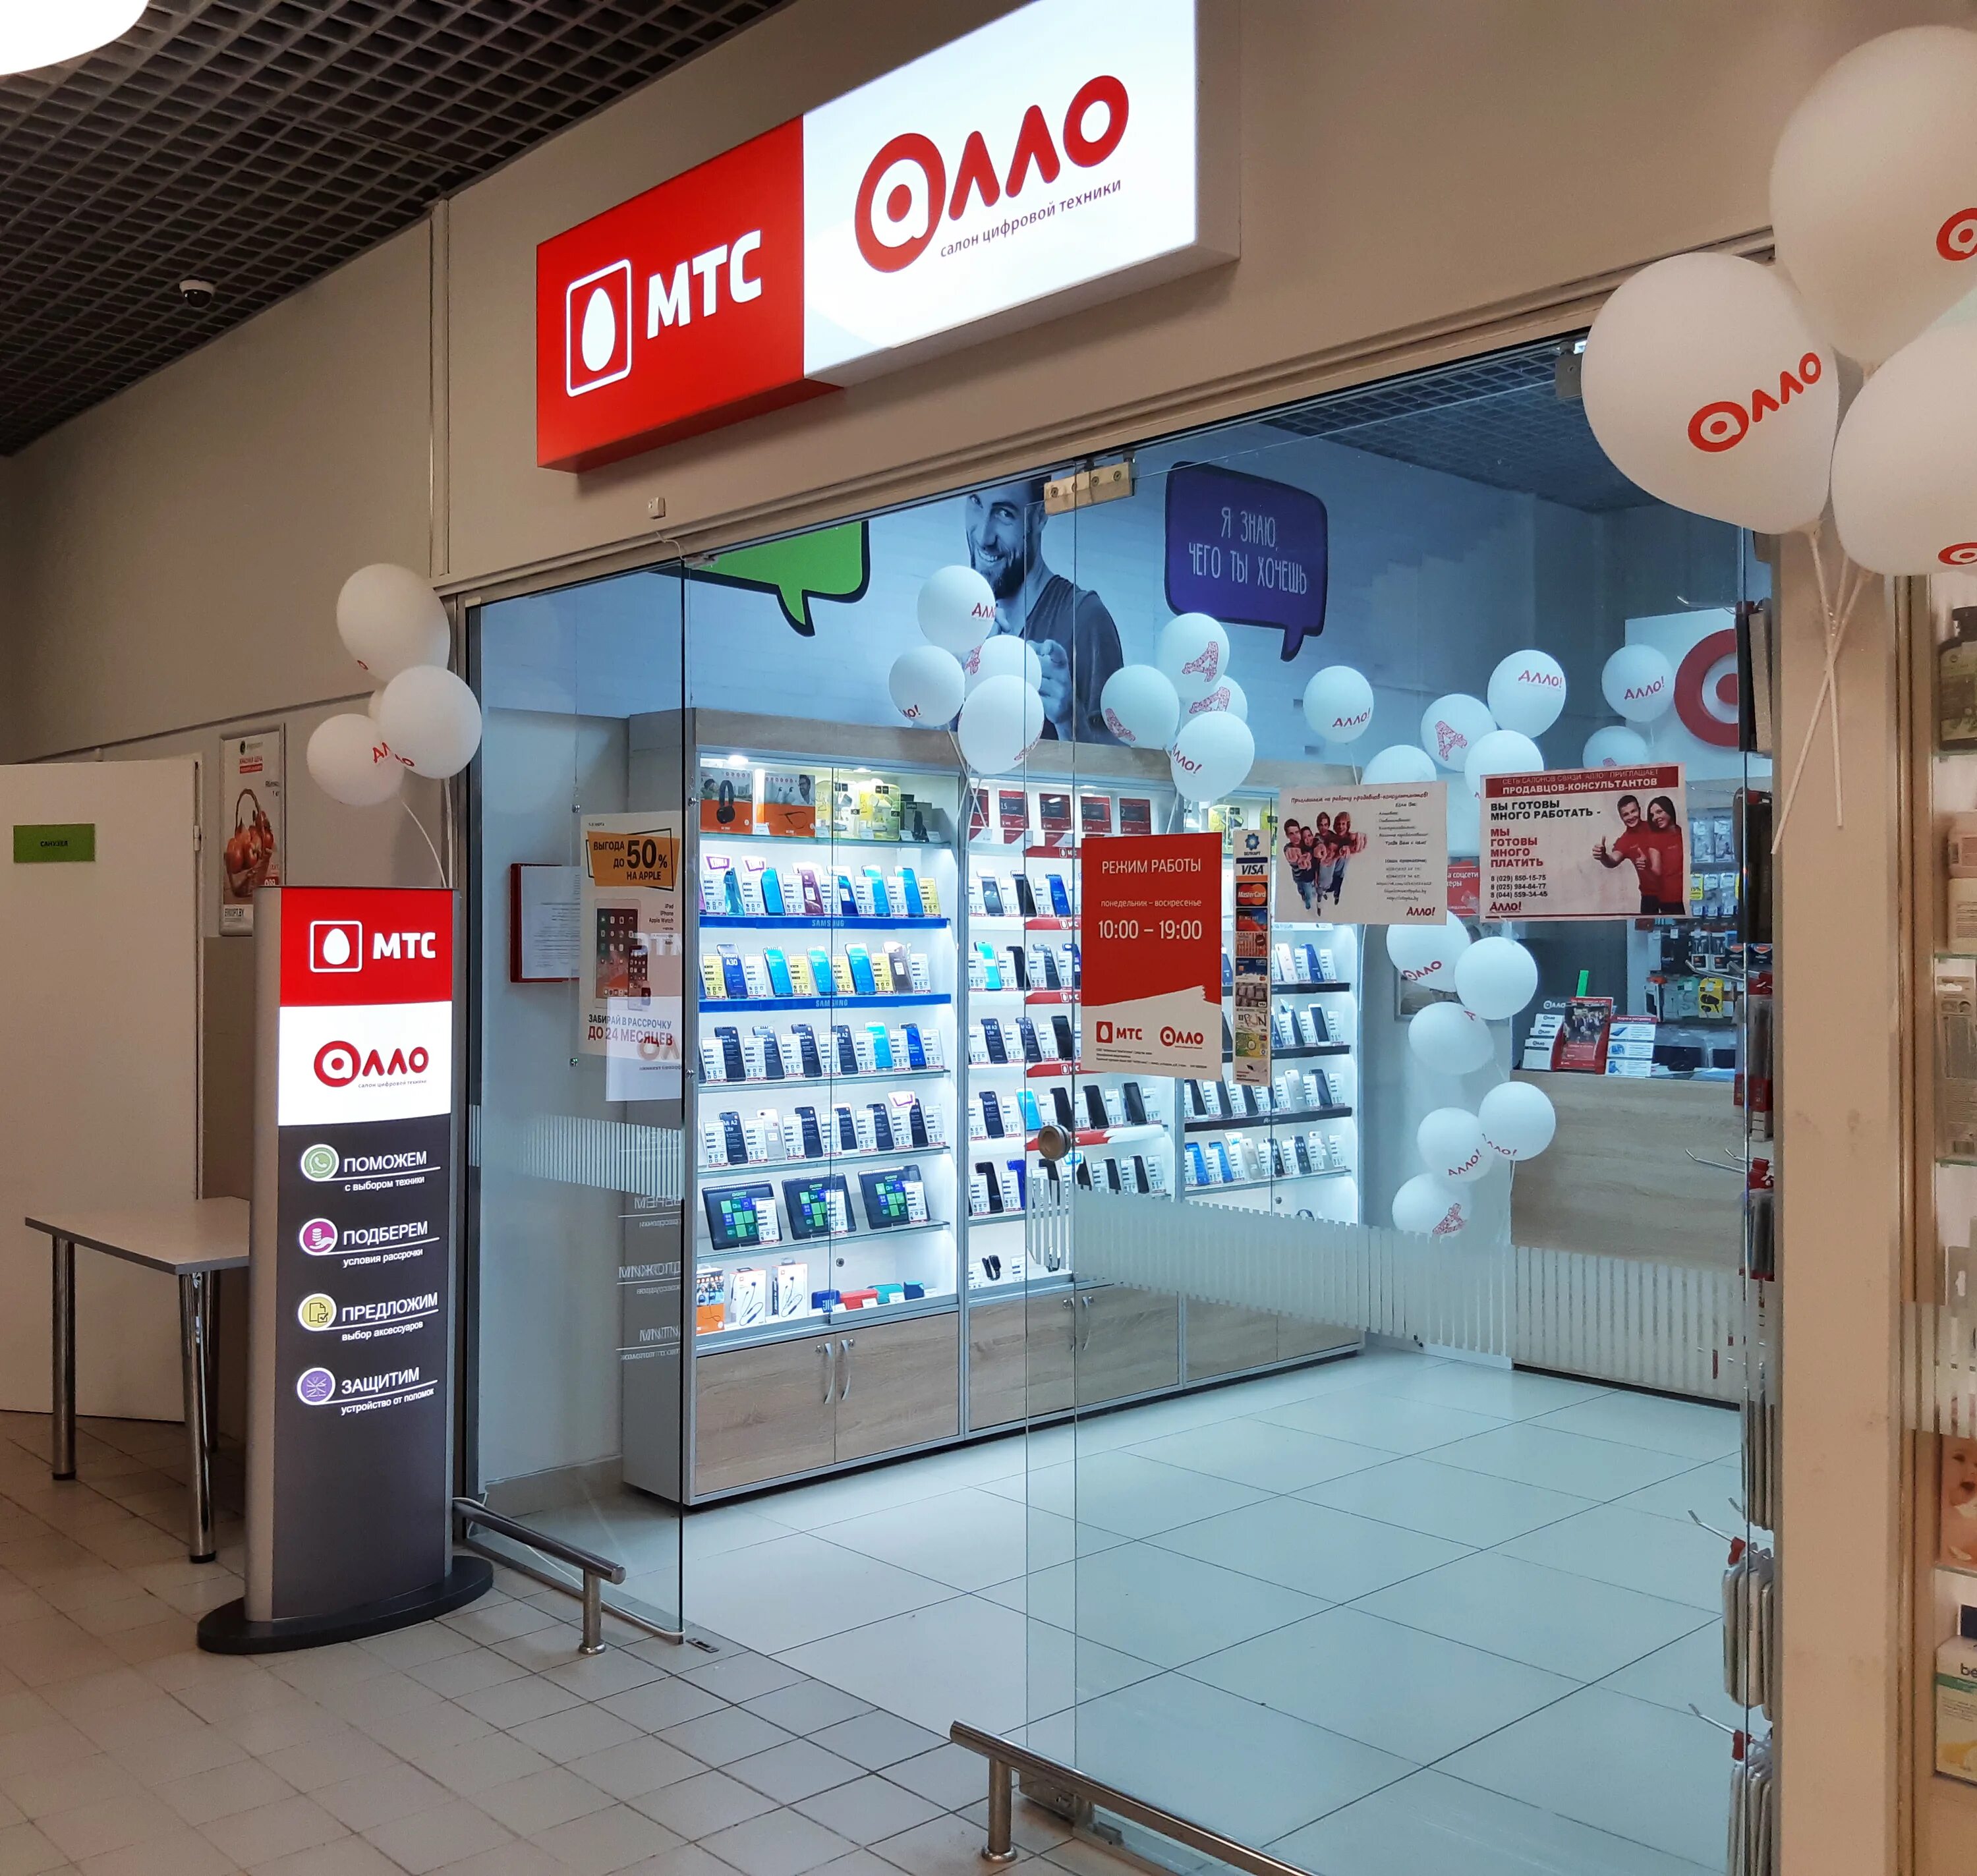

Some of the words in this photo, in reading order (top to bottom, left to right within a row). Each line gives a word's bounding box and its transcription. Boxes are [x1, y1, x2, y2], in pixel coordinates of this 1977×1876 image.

[940, 235, 979, 258] салон
[982, 202, 1056, 245] цифровой
[1058, 179, 1122, 214] техники
[647, 229, 763, 339] МТС
[1221, 507, 1231, 538] Я
[1189, 542, 1220, 579] ЧЕГО
[1230, 550, 1248, 584] ТЫ
[1257, 556, 1307, 594] ХОЧЕШЬ
[1557, 774, 1581, 782] СВЯЗИ
[1610, 769, 1658, 778] ПРИГЛАШАЕТ
[1503, 778, 1657, 795] ПРОДАВЦОВ-КОНСУЛЬТАНТОВ
[1491, 803, 1508, 811] ВЫ
[1512, 800, 1560, 810] ГОТОВЫ
[1491, 810, 1530, 820] МНОГО
[1534, 808, 1593, 818] РАБОТАТЬ
[594, 841, 625, 851] ВЫГОДА
[1491, 838, 1537, 846] ГОТОВЫ
[614, 858, 625, 868] ДО
[1102, 860, 1147, 874] РЕЖИМ
[1151, 858, 1201, 873] РАБОТЫ
[1242, 865, 1265, 874] VISA
[1491, 859, 1543, 868] ПЛАТИТЬ
[627, 871, 637, 880] НА
[639, 871, 662, 880] APPLE
[1099, 920, 1139, 939] 10:00
[1159, 920, 1202, 940] 19:00
[373, 932, 436, 959] МТС
[588, 1014, 620, 1025] ЗАБИРАЙ
[622, 1017, 626, 1025] В
[628, 1017, 672, 1029] РАССРОЧКУ
[588, 1025, 604, 1040] ДО
[606, 1028, 618, 1040] 24
[621, 1029, 673, 1046] МЕСЯЦЕВ
[1116, 1027, 1142, 1040] МТС
[344, 1151, 427, 1172] ПОМОЖЕМ
[353, 1179, 393, 1192] выбором
[395, 1176, 424, 1186] техники
[343, 1220, 428, 1245] ПОДБЕРЕМ
[343, 1254, 380, 1268] условия
[383, 1248, 423, 1263] рассрочки
[342, 1292, 438, 1322] ПРЕДЛОЖИМ
[342, 1330, 372, 1341] выбор
[374, 1321, 423, 1336] аксессуаров
[341, 1367, 420, 1395] ЗАЩИТИМ
[341, 1398, 391, 1415] устройство
[393, 1396, 402, 1406] от
[404, 1388, 434, 1403] поломок
